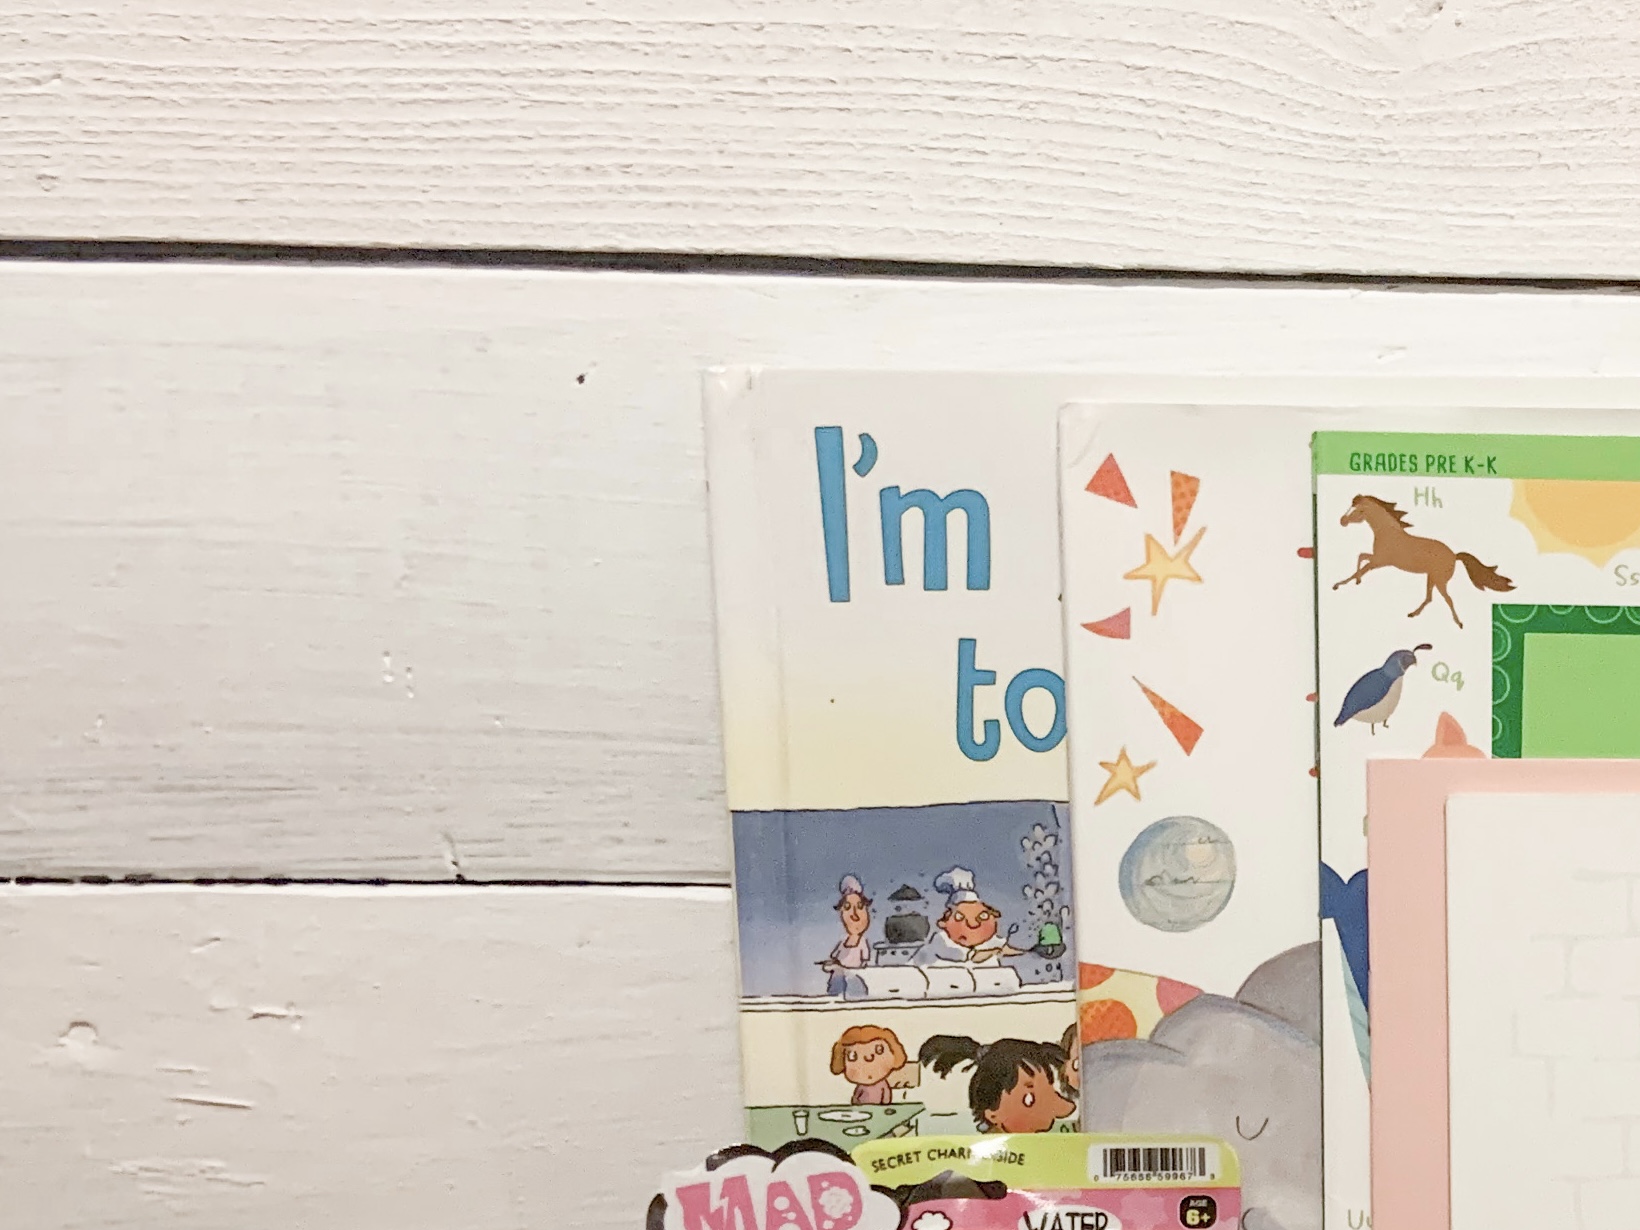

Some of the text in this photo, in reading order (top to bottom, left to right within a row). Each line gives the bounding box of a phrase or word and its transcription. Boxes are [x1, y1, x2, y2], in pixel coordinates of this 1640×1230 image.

[1350, 452, 1498, 475] GRADES PRE K-K
[1413, 486, 1444, 509] Hh
[814, 425, 991, 602] I'm
[1613, 564, 1640, 587] Ss
[1431, 661, 1465, 691] Qq
[956, 638, 1067, 762] to
[871, 1150, 922, 1173] SECRET
[927, 1147, 972, 1161] CHAR
[1186, 1210, 1211, 1225] 6+
